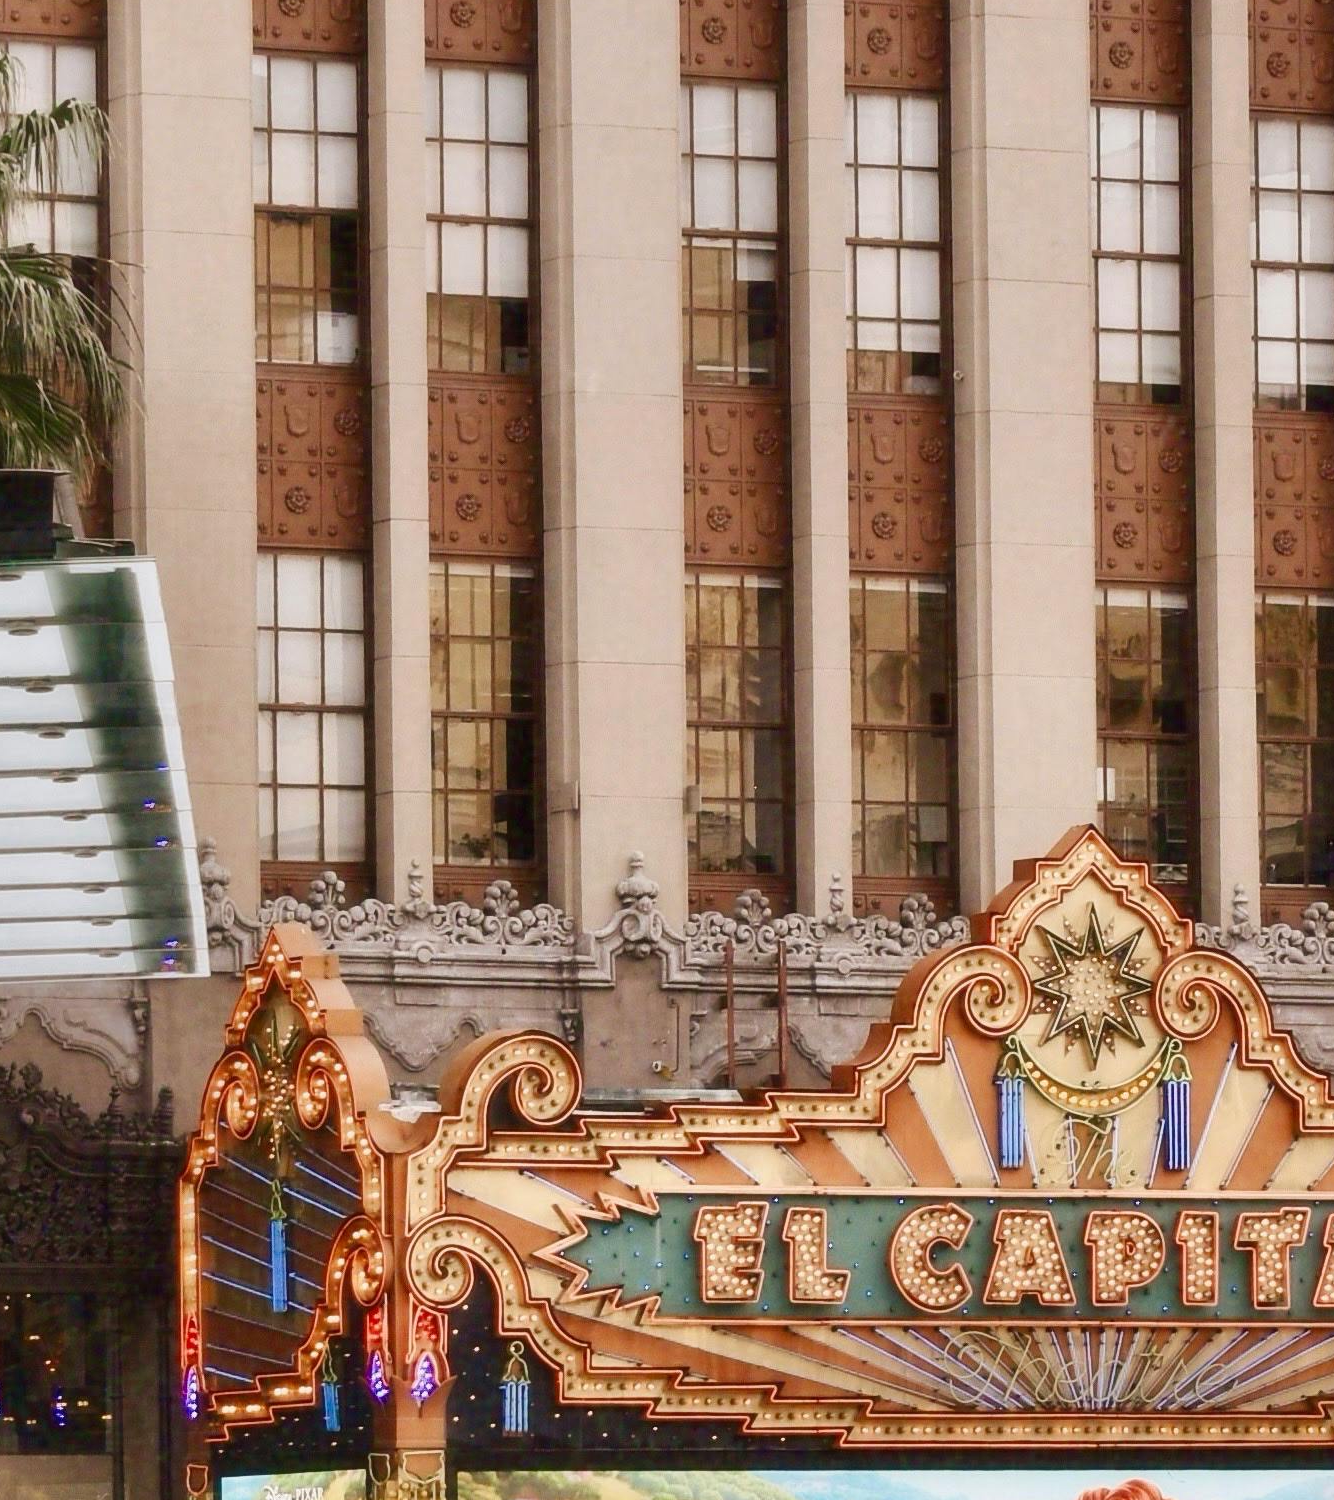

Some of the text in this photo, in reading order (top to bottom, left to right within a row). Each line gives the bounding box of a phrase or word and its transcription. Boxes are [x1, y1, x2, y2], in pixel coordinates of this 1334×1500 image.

[1040, 1115, 1140, 1188] The
[693, 1201, 851, 1304] EL
[944, 1331, 1240, 1403] Theatre
